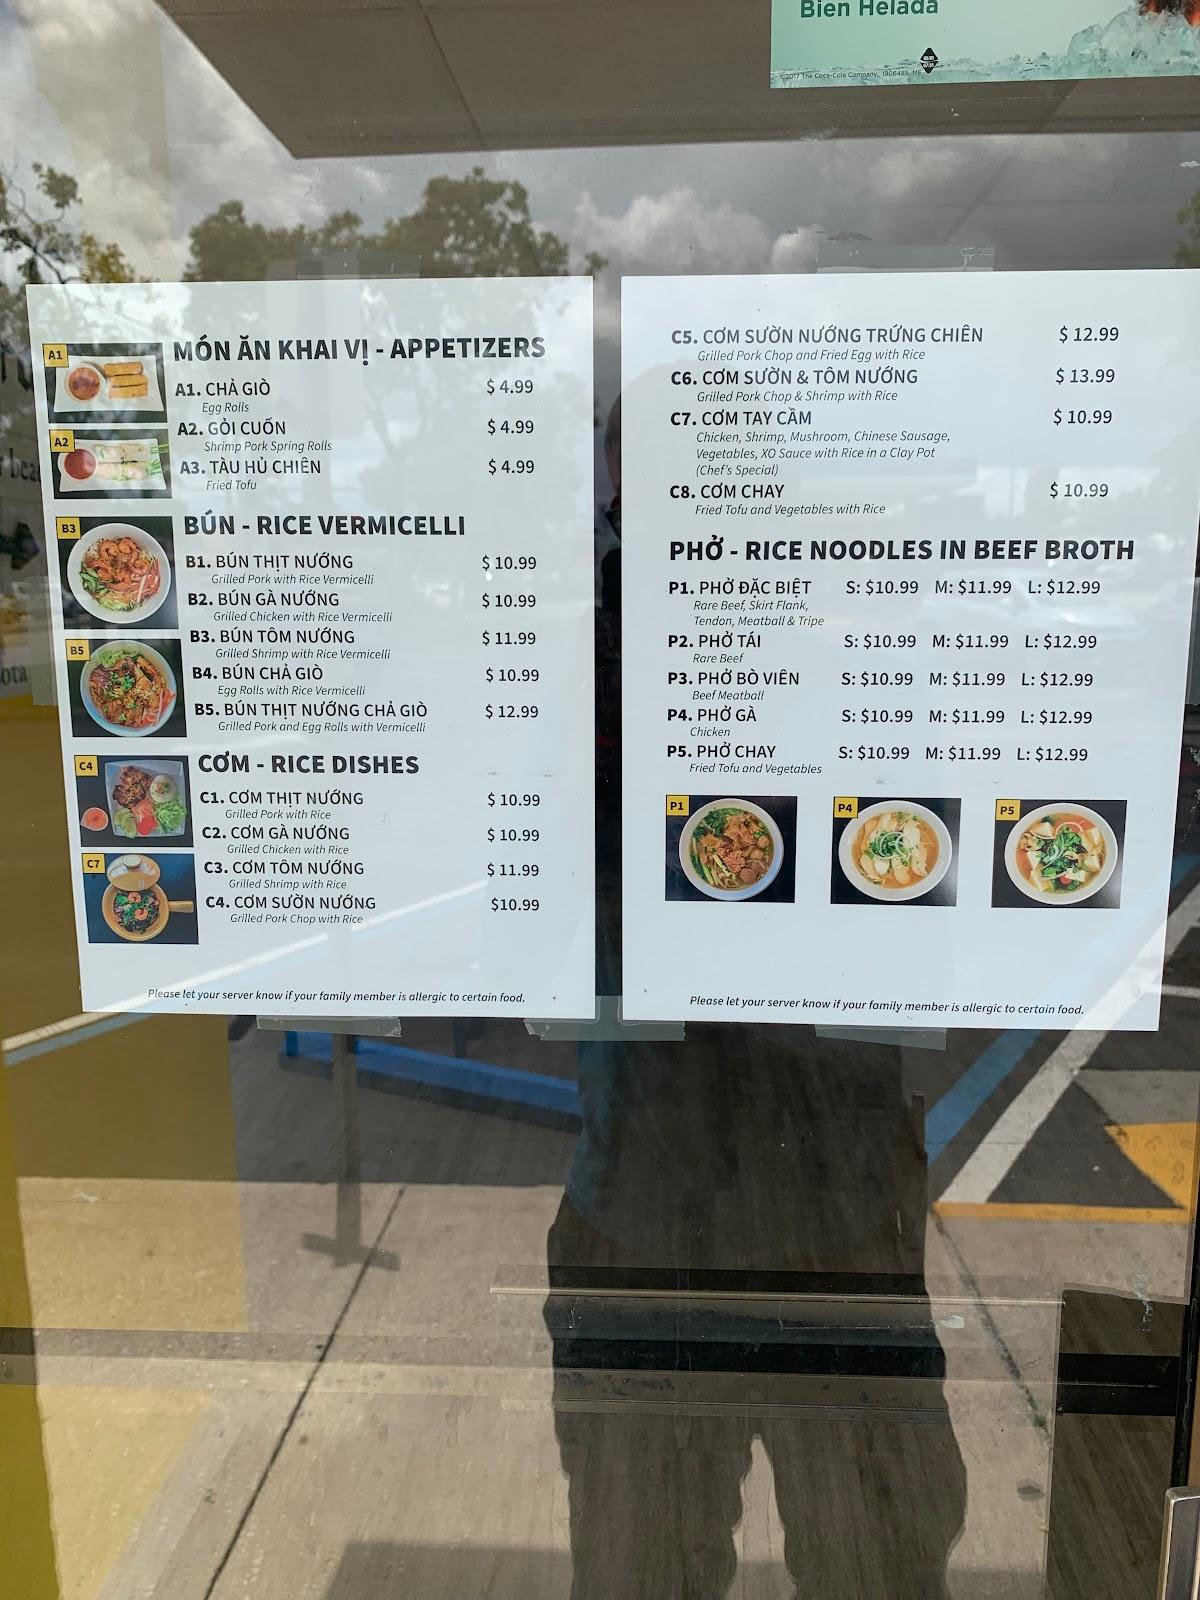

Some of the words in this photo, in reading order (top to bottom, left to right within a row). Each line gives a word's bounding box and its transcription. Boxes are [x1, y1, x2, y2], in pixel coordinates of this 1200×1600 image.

[800, 0, 849, 18] Bien
[859, 0, 938, 16] Helada
[672, 329, 698, 345] C5.
[703, 326, 739, 345] CƠM
[745, 324, 792, 344] SƯỜN
[799, 324, 861, 344] NƯỚNG
[866, 324, 925, 343] TRỨNG
[931, 323, 982, 343] CHIÊN
[49, 351, 62, 360] A1
[173, 334, 231, 362] MÓN
[237, 335, 271, 361] ĂN
[279, 338, 338, 361] KHAI
[344, 338, 369, 366] VỊ
[390, 336, 546, 359] APPETIZERS
[175, 383, 201, 397] A1.
[206, 377, 238, 397] CHẢ
[242, 377, 270, 396] GIÒ
[202, 401, 221, 415] Egg
[225, 401, 249, 413] Rolls
[671, 411, 696, 426] C7.
[702, 408, 737, 426] CƠM
[743, 410, 772, 426] TAY
[777, 406, 811, 425] CẦM
[178, 422, 203, 436] A2.
[208, 417, 235, 436] GỎI
[241, 417, 285, 436] CUỐN
[55, 438, 68, 447] A2
[697, 430, 741, 445] Chicken,
[745, 431, 786, 446] Shrimp,
[790, 430, 850, 444] Mushroom,
[854, 430, 897, 442] Chinese
[900, 430, 950, 445] Sausage,
[204, 439, 241, 454] Shrimp
[245, 440, 268, 452] Pork
[271, 440, 304, 455] Spring
[307, 440, 332, 453] Rolls
[697, 448, 757, 462] Vegetables,
[760, 448, 776, 459] XO
[778, 447, 811, 459] Sauce
[815, 446, 838, 458] with
[841, 446, 864, 459] Rice
[867, 446, 876, 459] in
[880, 449, 887, 458] a
[890, 447, 914, 462] Clay
[916, 447, 936, 458] Pot
[180, 461, 205, 474] A3.
[210, 457, 239, 474] TÀU
[245, 456, 267, 474] HỦ
[272, 457, 320, 474] CHIÊN
[735, 463, 778, 478] Special)
[62, 524, 76, 533] B3
[184, 509, 235, 536] BÚN
[257, 515, 312, 536] RICE
[318, 515, 464, 535] VERMICELLI
[670, 534, 724, 561] PHỞ
[746, 540, 802, 561] RICE
[811, 539, 932, 560] NOODLES
[940, 539, 966, 560] IN
[974, 540, 1038, 560] BEEF
[1045, 540, 1135, 561] BROTH
[186, 555, 211, 569] B1.
[216, 551, 248, 569] BÚN
[253, 554, 289, 572] THỊT
[295, 551, 353, 568] NƯỚNG
[669, 580, 694, 594] P1.
[700, 576, 734, 595] PHỞ
[738, 577, 770, 599] ĐẶC
[776, 577, 811, 599] BIỆT
[846, 580, 860, 595] S:
[866, 579, 918, 597] $10.99
[935, 580, 953, 594] M:
[958, 578, 1011, 596] $11.99
[1029, 580, 1041, 594] L:
[1047, 578, 1100, 596] $12.99
[694, 601, 718, 610] Rare
[721, 600, 746, 612] Beef,
[749, 600, 775, 610] Skirt
[776, 600, 808, 612] Flank,
[695, 615, 734, 628] Tendon,
[738, 615, 785, 626] Meatball
[799, 615, 824, 629] Tripe
[190, 630, 215, 643] B3.
[220, 626, 252, 643] BÚN
[257, 626, 291, 643] TÔM
[297, 626, 354, 644] NƯỚNG
[71, 647, 84, 655] B5
[195, 703, 219, 716] B5.
[225, 699, 256, 716] BÚN
[261, 703, 297, 721] THỊT
[302, 700, 359, 717] NƯỚNG
[364, 700, 396, 717] CHẢ
[400, 700, 427, 717] GIÒ
[667, 745, 692, 758] P5.
[698, 741, 730, 759] PHỞ
[735, 745, 776, 759] CHAY
[80, 762, 93, 771] C4
[198, 750, 249, 773] CƠM
[272, 754, 325, 774] RICE
[332, 755, 419, 775] DISHES
[200, 791, 224, 804] C1.
[229, 789, 262, 804] CƠM
[266, 791, 302, 808] THỊT
[307, 788, 363, 805] NƯỚNG
[670, 801, 685, 811] P1
[838, 804, 853, 813] P4
[1000, 806, 1015, 816] P5
[227, 843, 260, 855] Grilled
[262, 843, 301, 855] Chicken
[304, 843, 325, 855] with
[328, 844, 349, 855] Rice
[87, 860, 100, 869] C7
[206, 896, 230, 909] C4.
[234, 894, 266, 909] CƠM
[272, 893, 314, 909] SƯỜN
[320, 893, 375, 909] NƯỚNG
[491, 897, 539, 912] $10.99
[230, 912, 263, 923] Grilled
[265, 912, 287, 923] Pork
[290, 913, 317, 927] Chop
[319, 914, 340, 924] with
[343, 914, 364, 924] Rice
[148, 988, 180, 999] Please
[183, 989, 195, 999] let
[197, 991, 220, 1001] your
[222, 992, 254, 1000] server
[256, 990, 283, 1000] know
[285, 990, 293, 1000] if
[294, 993, 317, 1003] your
[320, 990, 351, 1004] family
[354, 991, 396, 1001] member
[399, 991, 406, 1001] is
[409, 991, 447, 1004] allergic
[450, 993, 459, 1002] to
[462, 992, 497, 1002] certain
[500, 992, 525, 1003] food.
